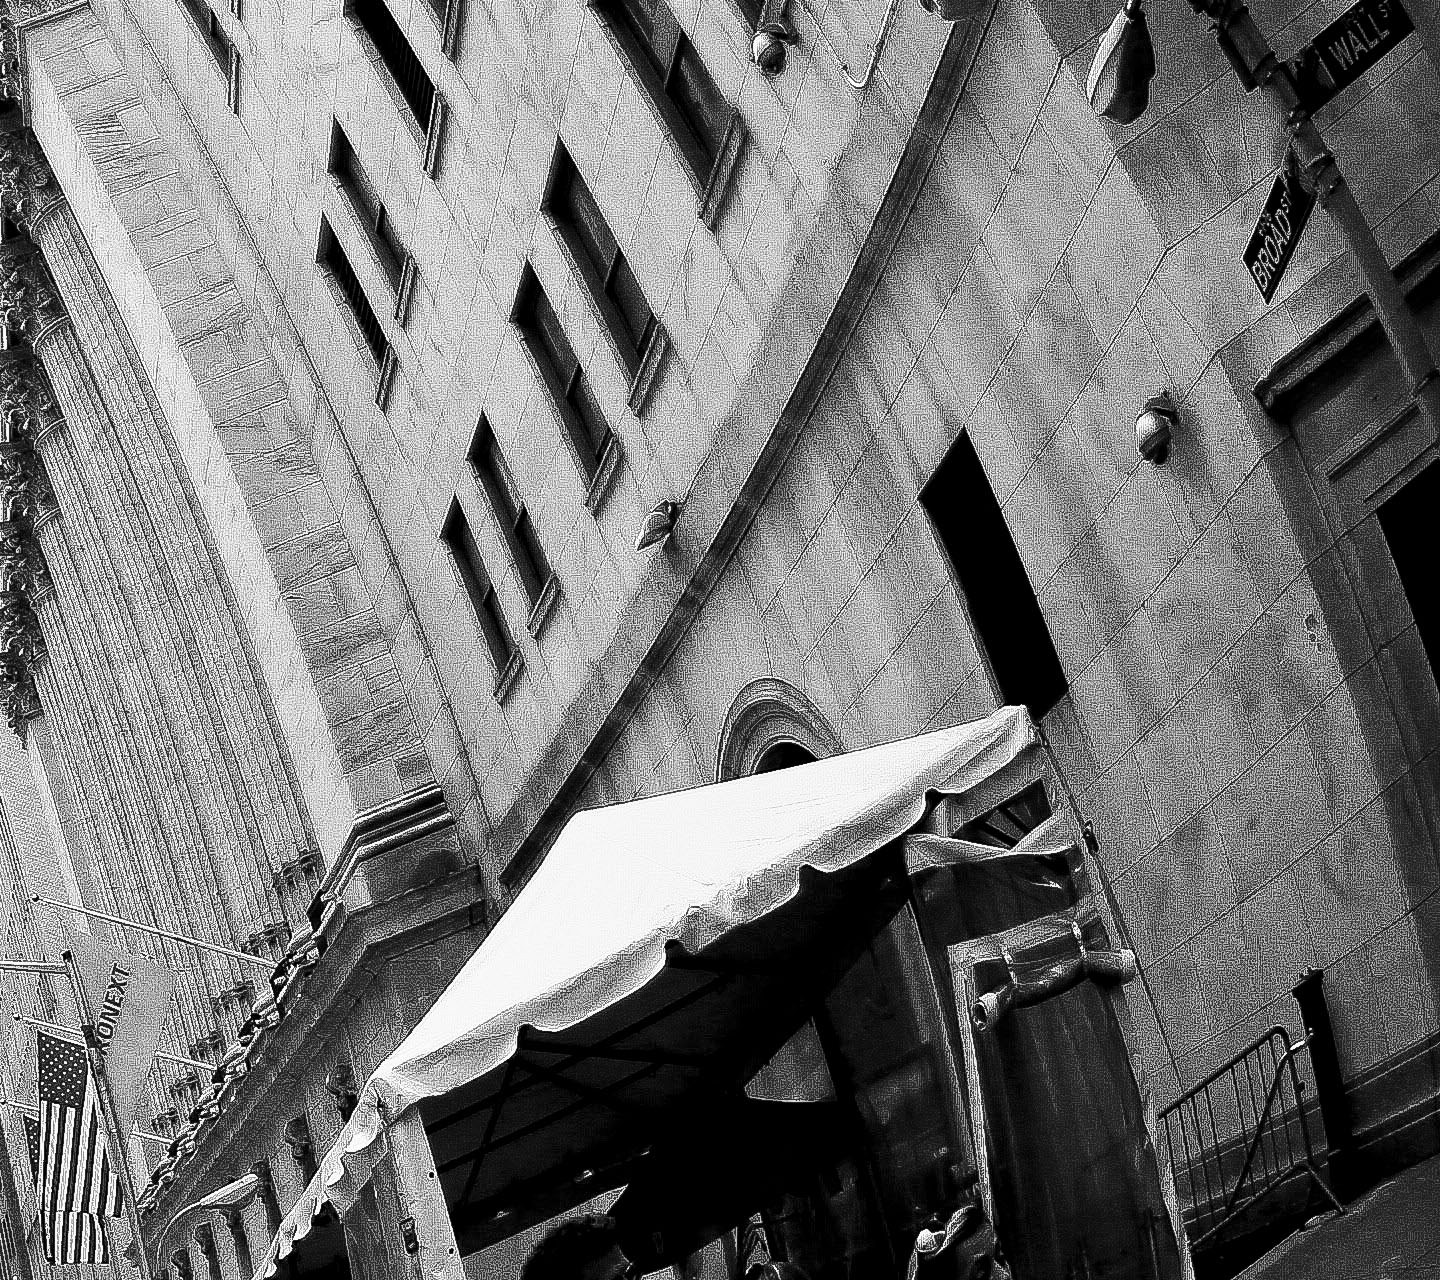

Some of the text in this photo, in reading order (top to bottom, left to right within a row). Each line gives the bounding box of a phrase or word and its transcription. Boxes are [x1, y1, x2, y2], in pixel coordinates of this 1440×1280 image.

[1328, 12, 1391, 71] WALL
[1251, 211, 1293, 293] BROAD
[1280, 189, 1293, 215] ST
